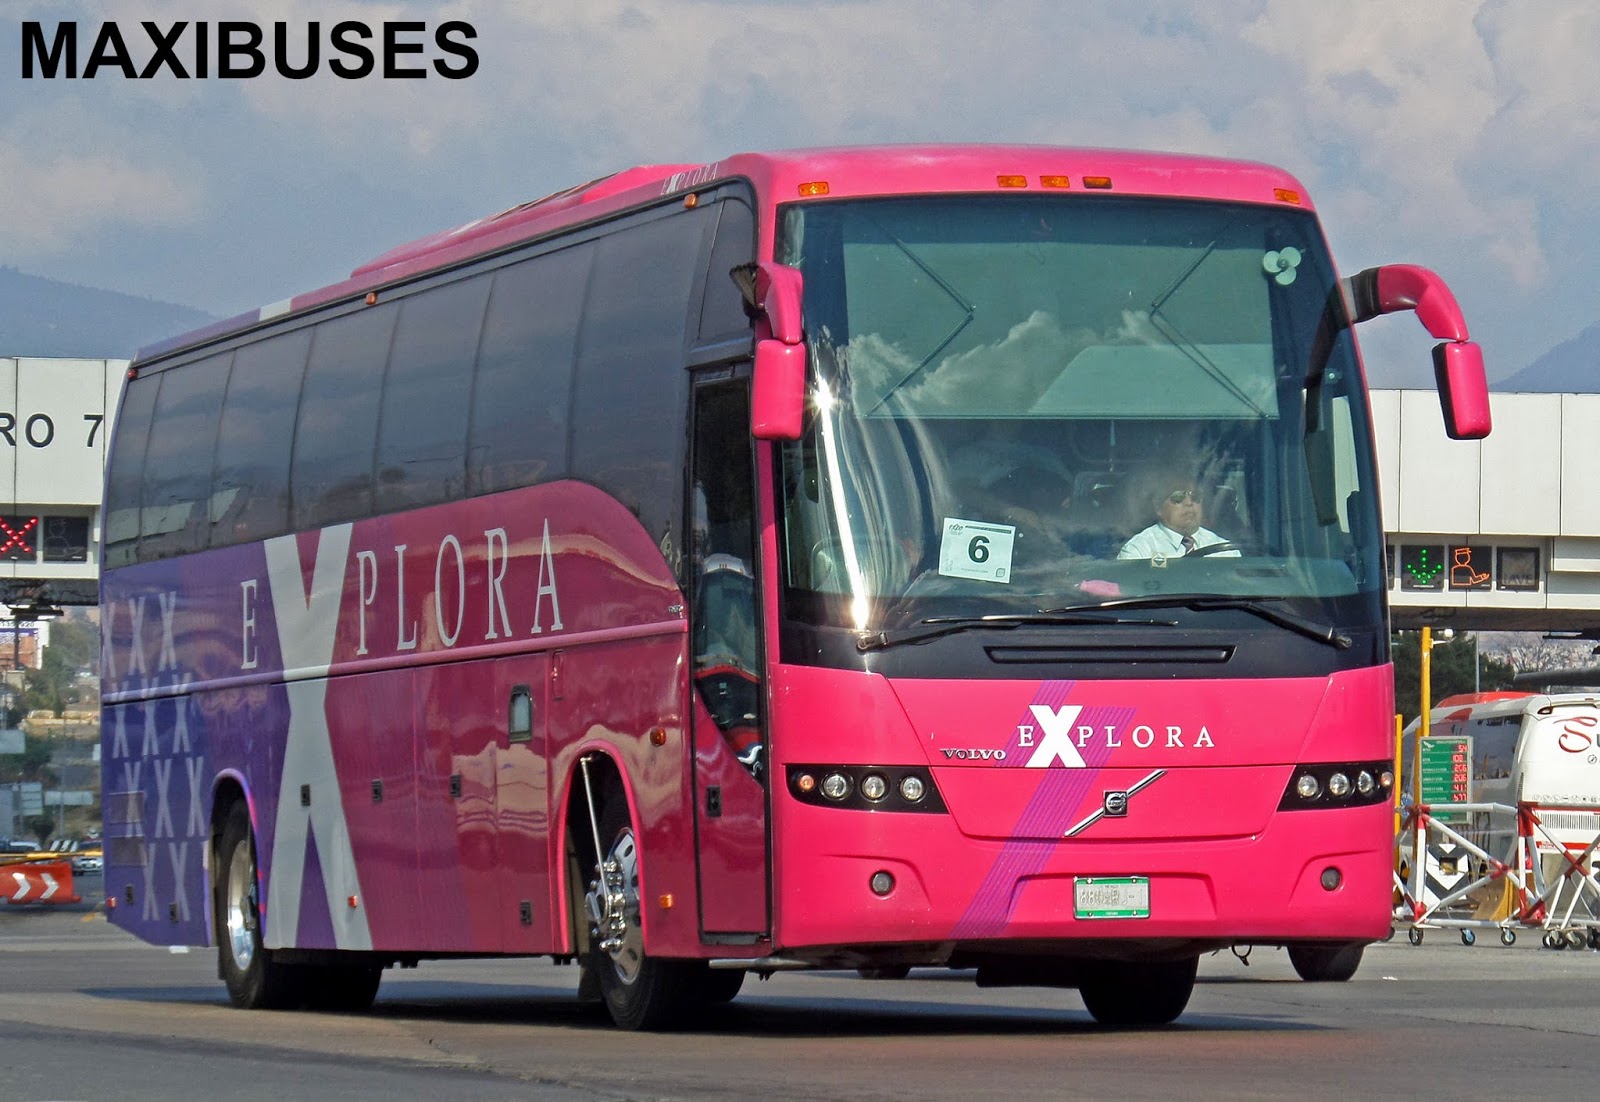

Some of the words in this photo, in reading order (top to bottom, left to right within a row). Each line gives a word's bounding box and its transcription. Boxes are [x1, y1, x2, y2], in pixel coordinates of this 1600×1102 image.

[83, 414, 104, 448] 7
[968, 535, 990, 564] 6
[241, 518, 564, 952] EXPLORA
[1017, 705, 1215, 768] EXPLORA
[940, 748, 1007, 761] VOLVO
